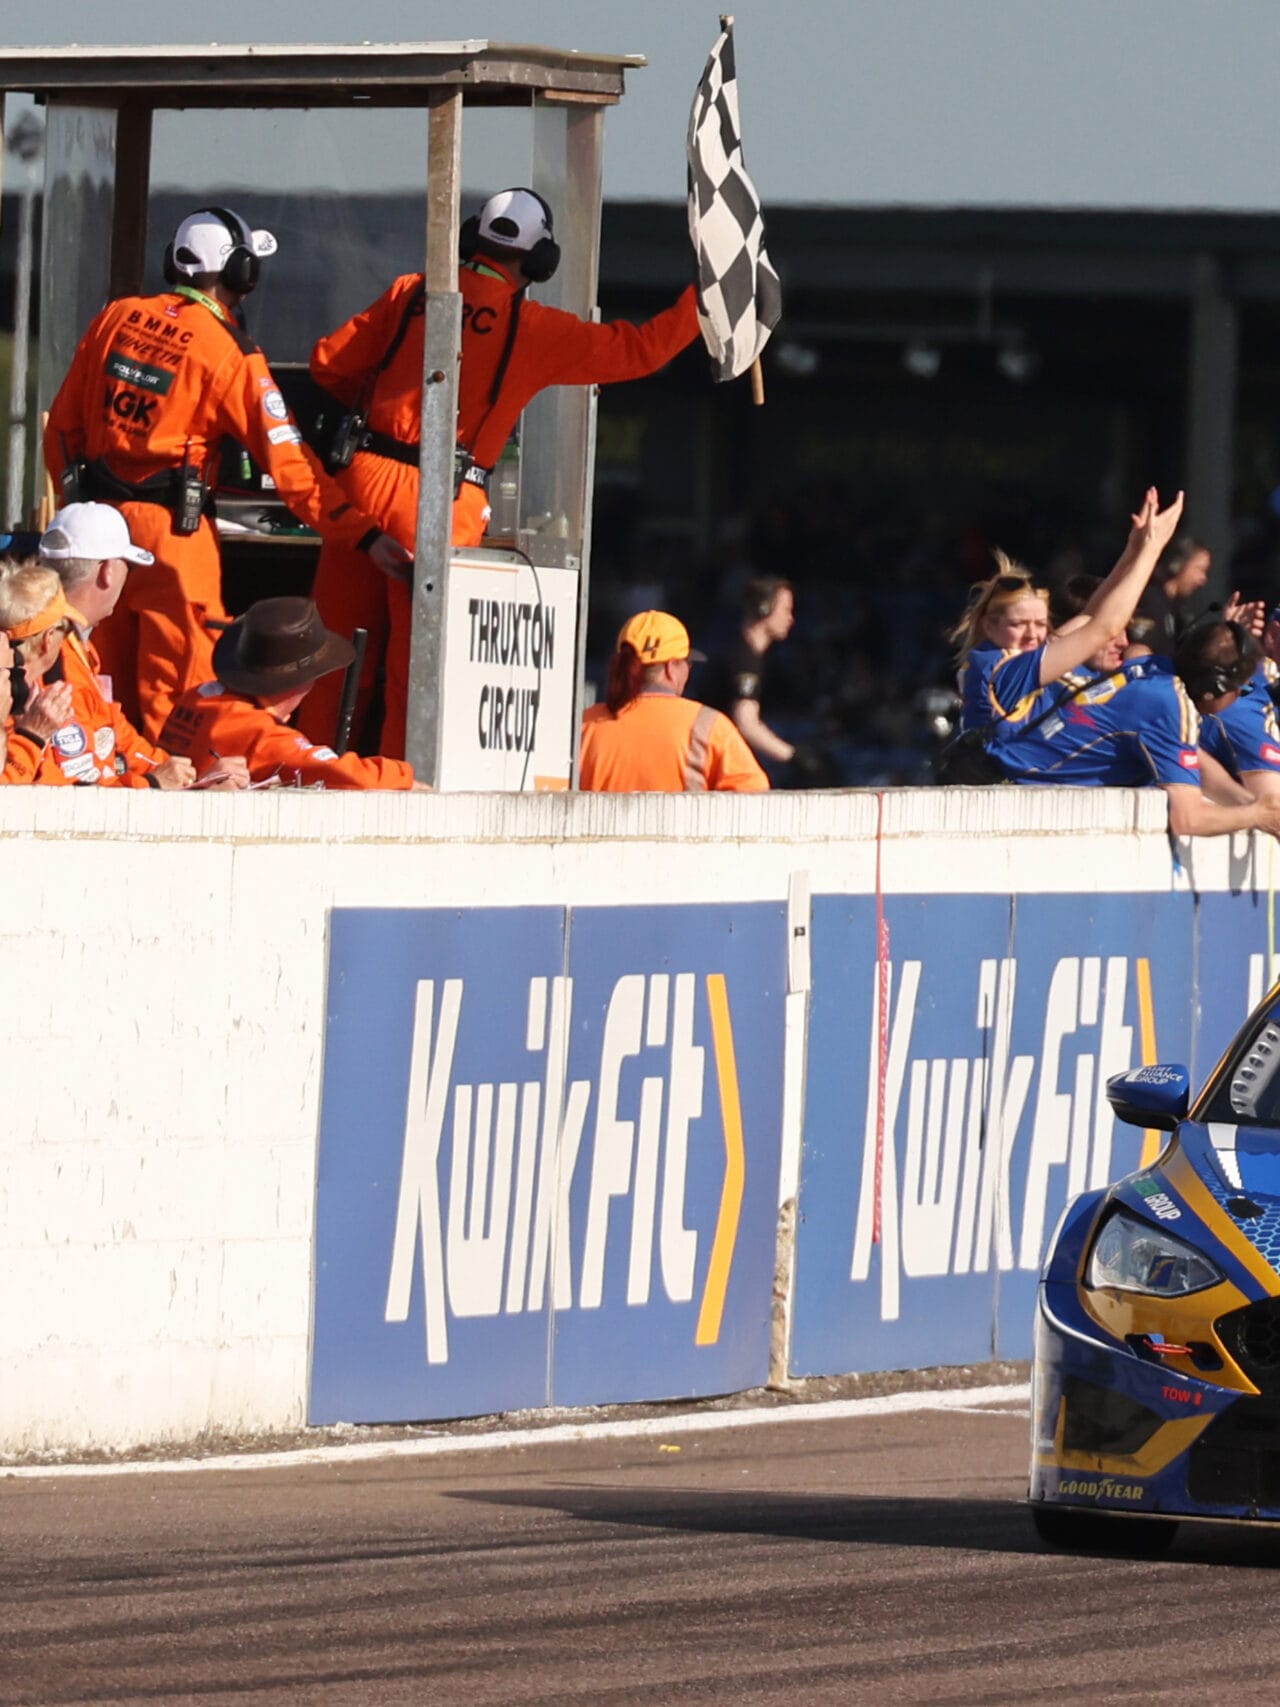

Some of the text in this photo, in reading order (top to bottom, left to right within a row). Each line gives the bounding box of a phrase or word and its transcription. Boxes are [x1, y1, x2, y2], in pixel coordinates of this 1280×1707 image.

[468, 598, 555, 670] THRUXTON
[478, 684, 540, 753] CIRCUIT
[1162, 1385, 1191, 1403] TOW
[1058, 1478, 1144, 1500] GOODYEAR
